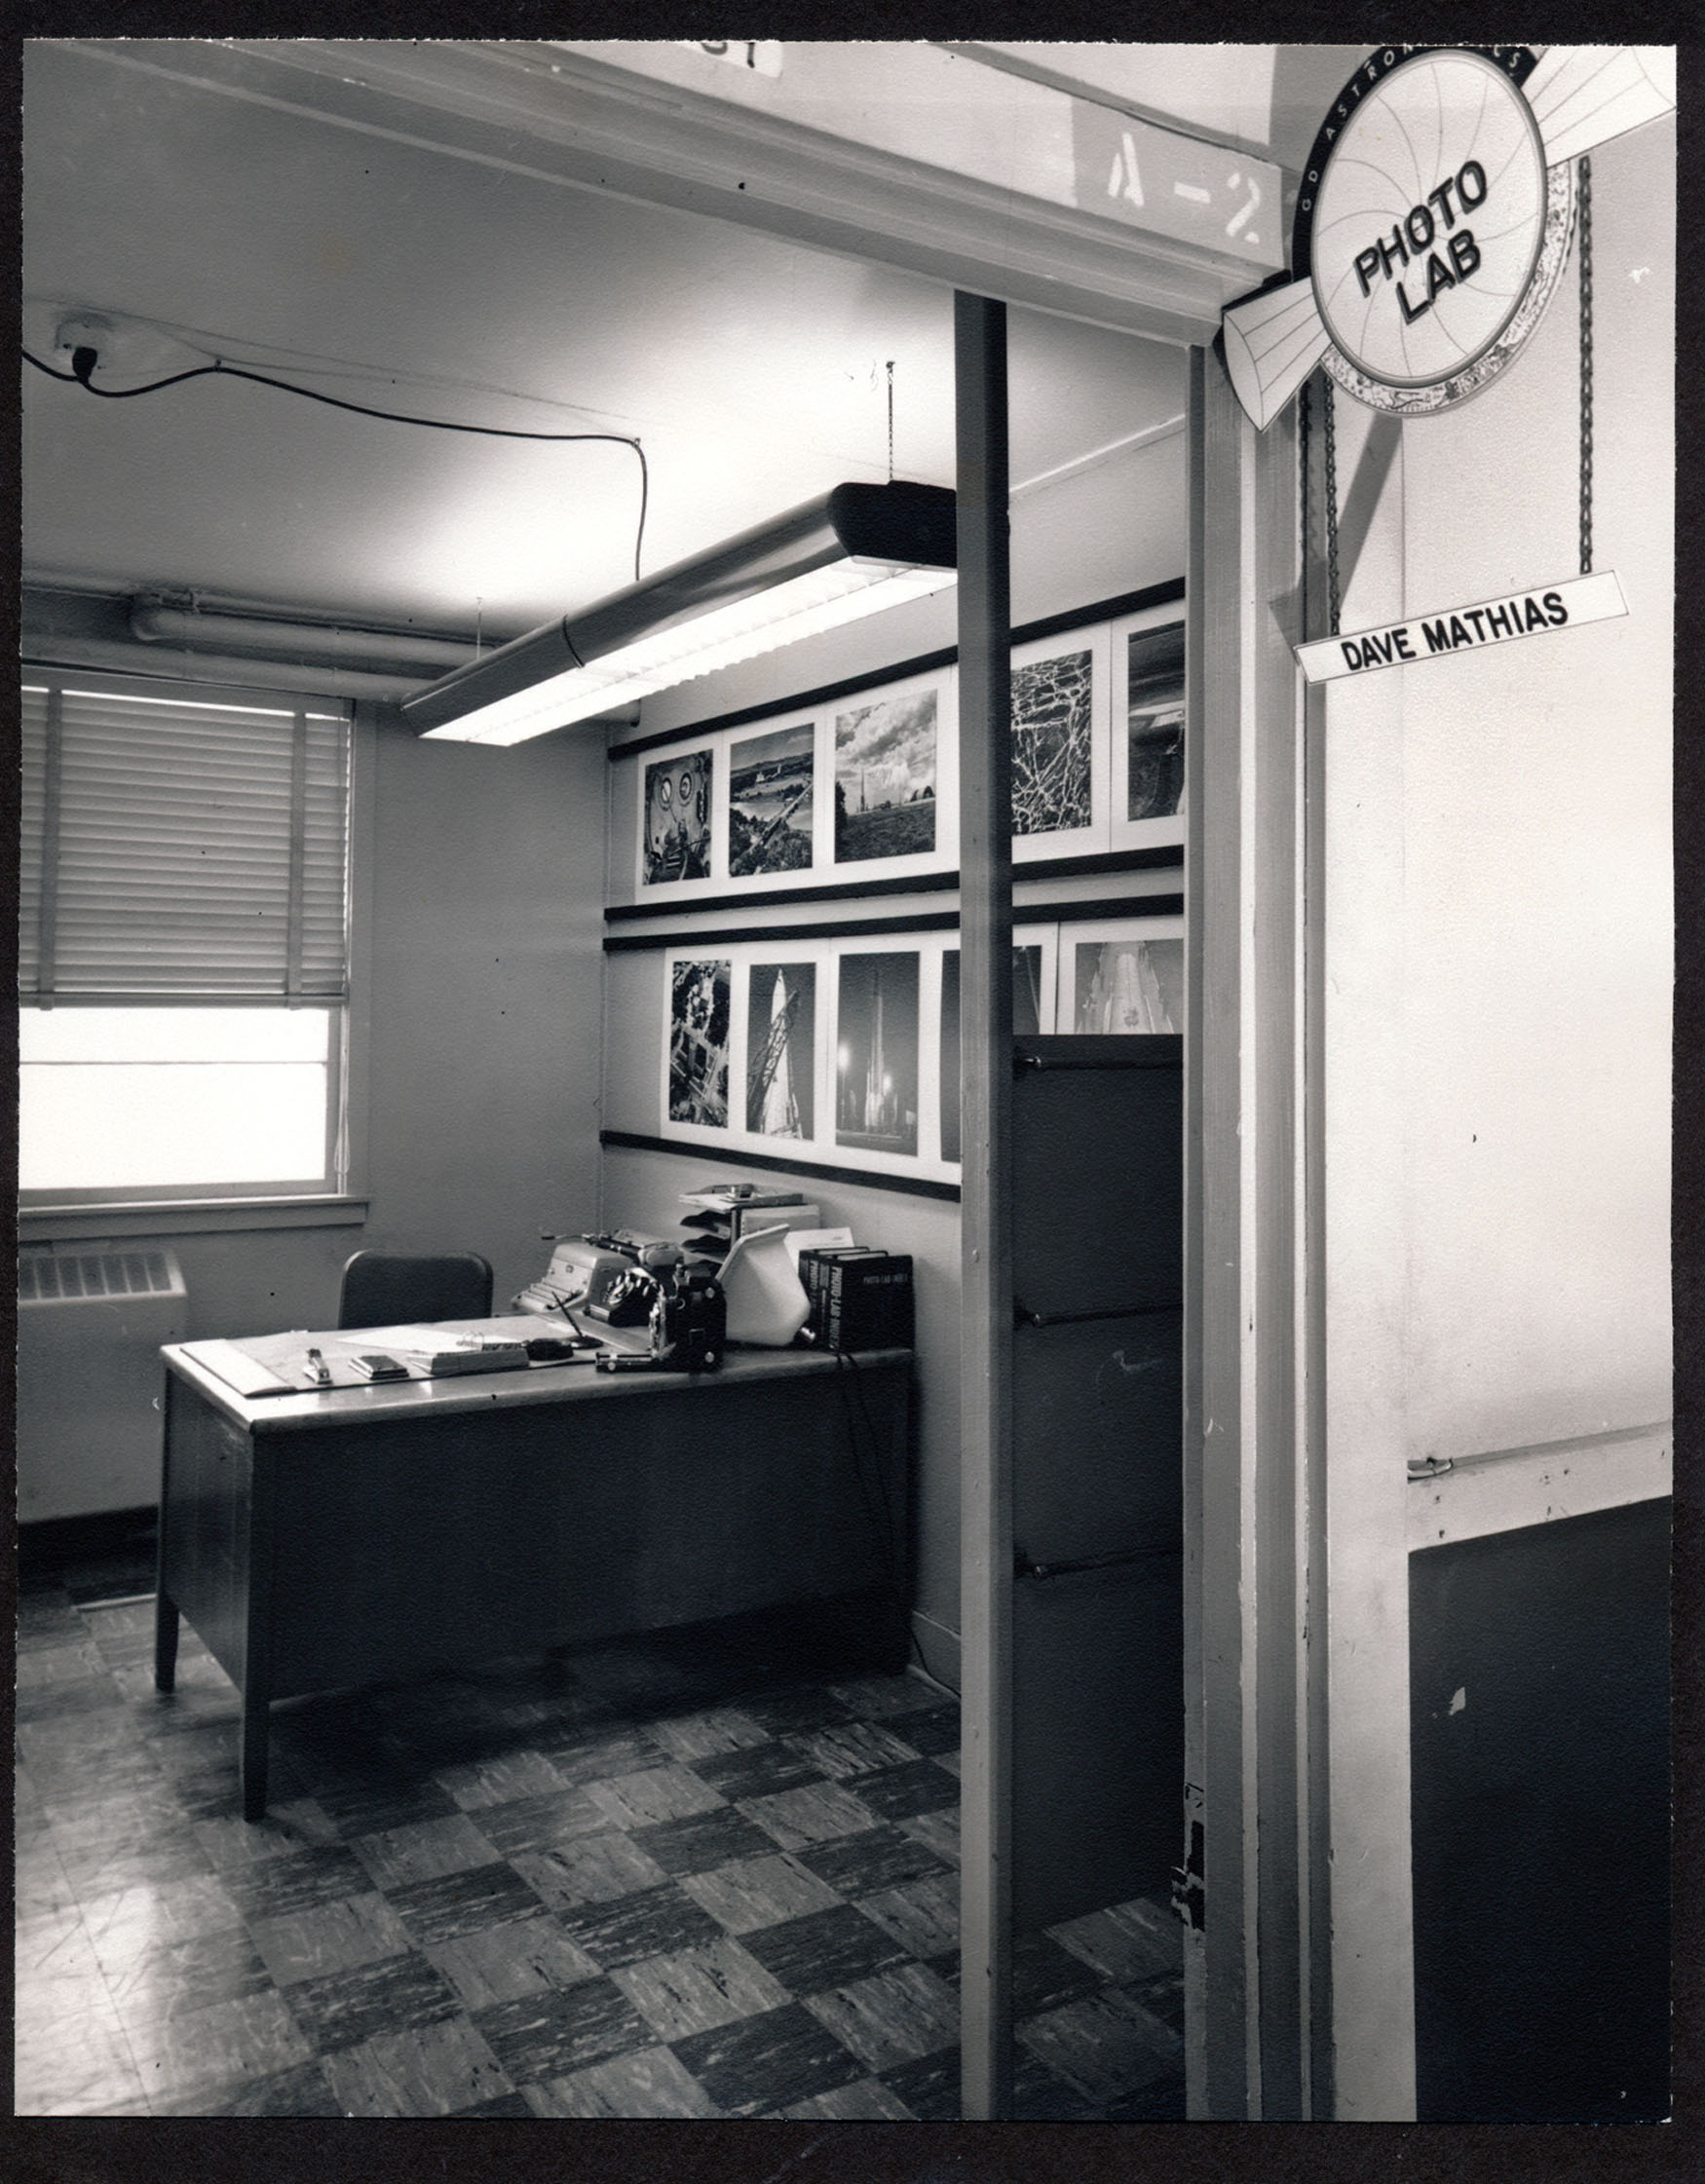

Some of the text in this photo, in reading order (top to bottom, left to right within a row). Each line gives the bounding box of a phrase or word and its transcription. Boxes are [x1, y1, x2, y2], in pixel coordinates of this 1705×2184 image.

[1353, 160, 1488, 297] PHOTO
[1396, 229, 1481, 324] LAB
[1341, 592, 1569, 671] DAVE MATHIAS
